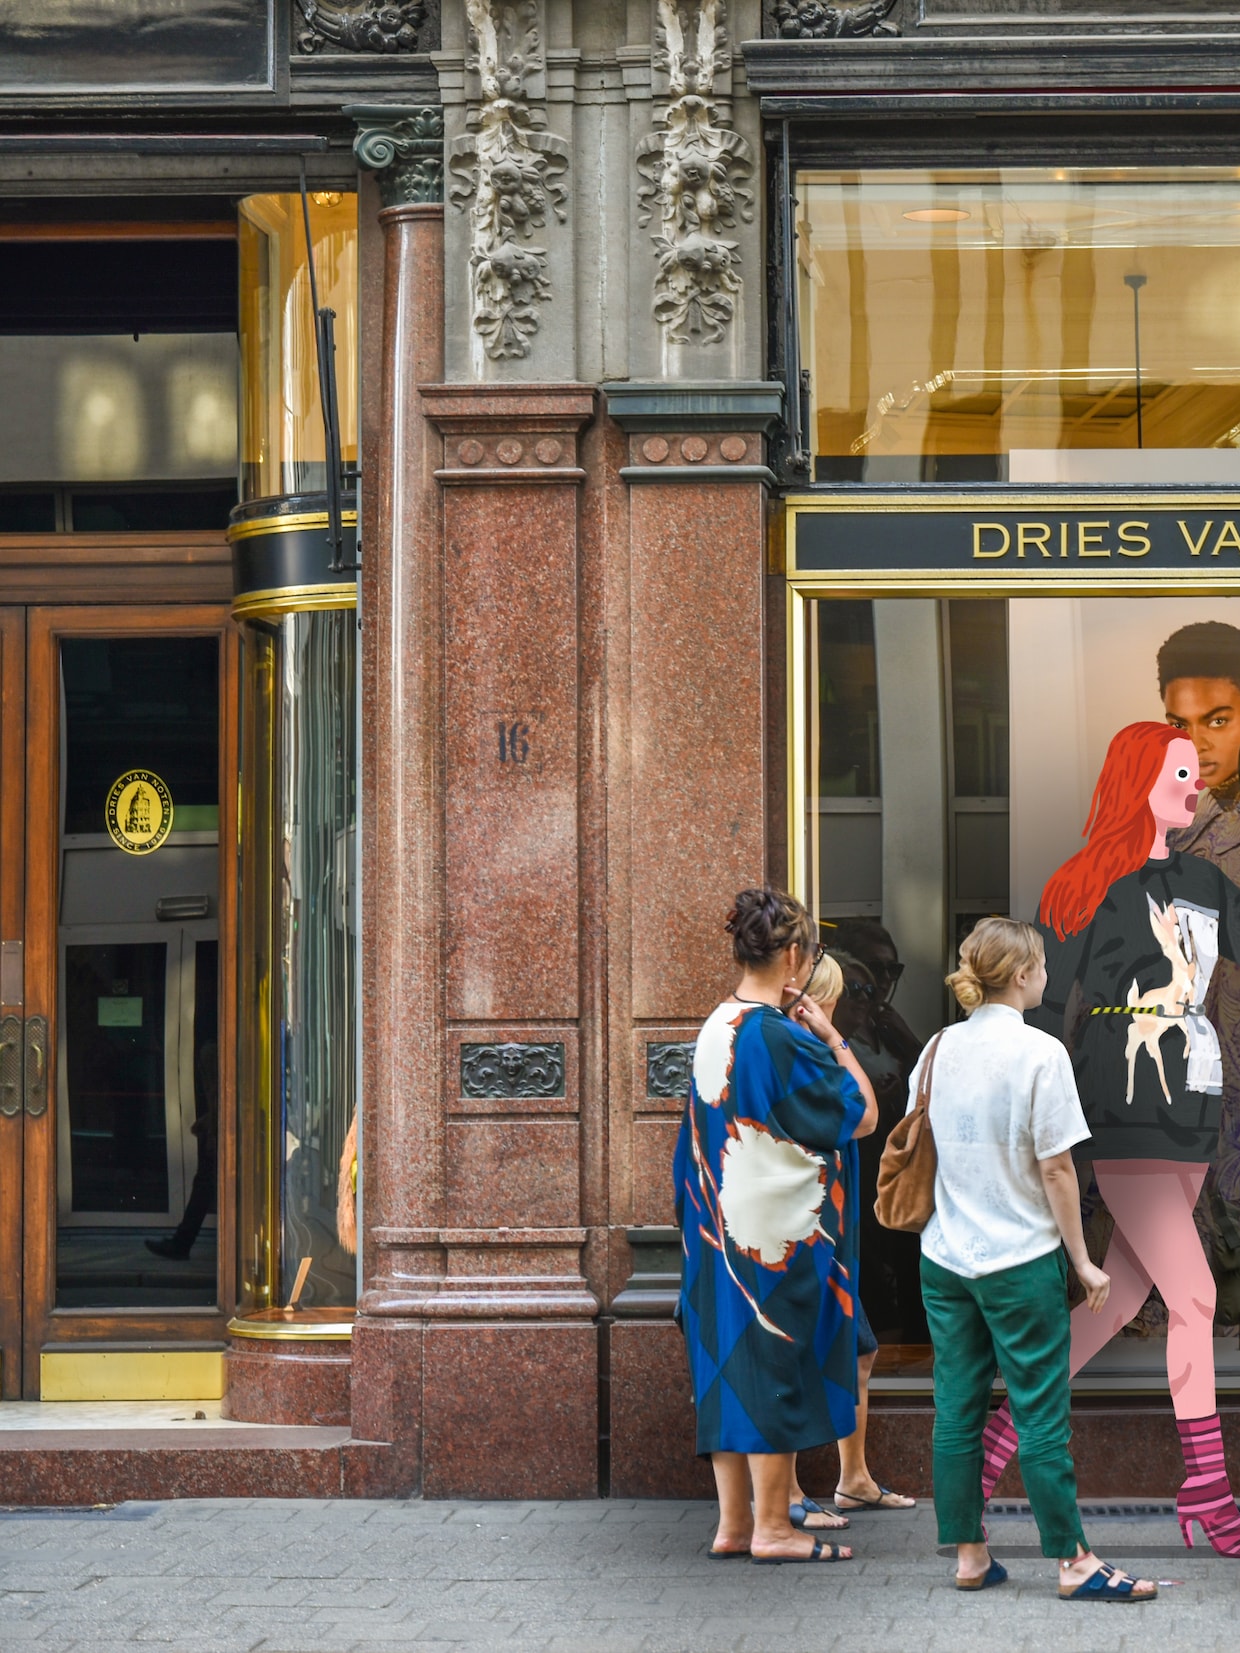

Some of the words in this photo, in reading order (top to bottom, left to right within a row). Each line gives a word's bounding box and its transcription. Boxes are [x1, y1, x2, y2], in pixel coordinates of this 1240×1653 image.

[972, 521, 1152, 558] DRIES
[498, 721, 530, 763] 16
[108, 782, 125, 816] DRIES
[126, 773, 149, 782] VAN
[151, 779, 170, 816] NOTEN
[112, 827, 141, 851] SINCE
